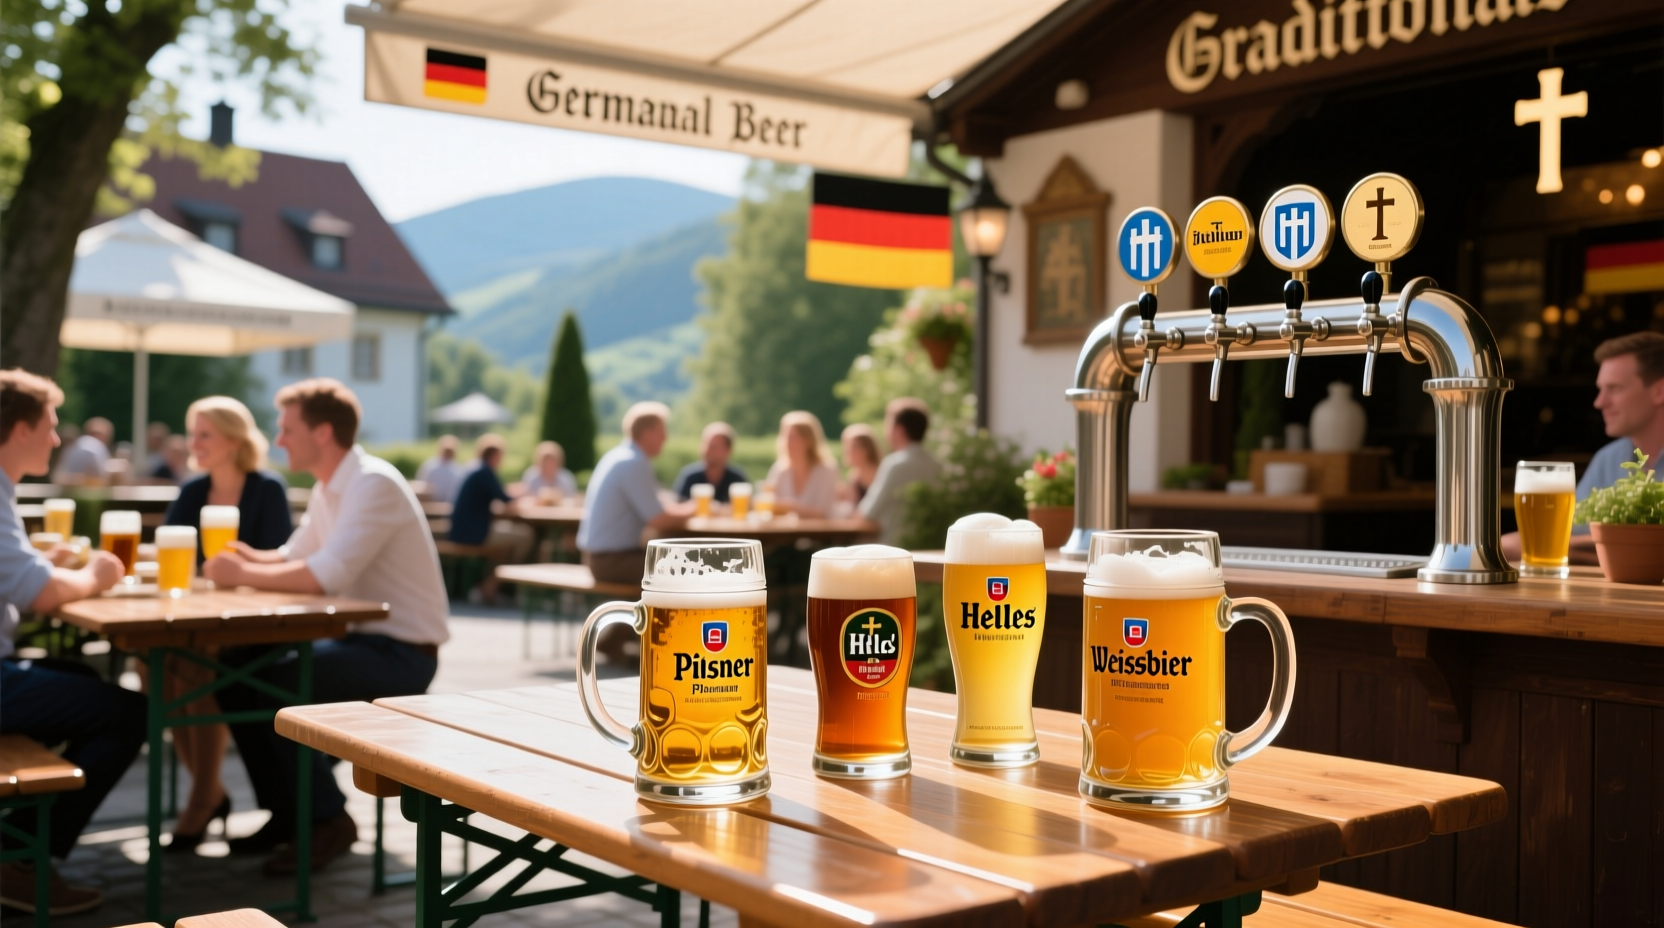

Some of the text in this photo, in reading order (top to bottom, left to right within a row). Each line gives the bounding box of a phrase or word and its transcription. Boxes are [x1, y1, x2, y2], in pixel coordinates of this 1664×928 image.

[527, 70, 807, 149] Germanal Beer
[960, 602, 1036, 630] Helles
[673, 653, 754, 681] Pilsner
[1090, 645, 1193, 676] Weissbier
